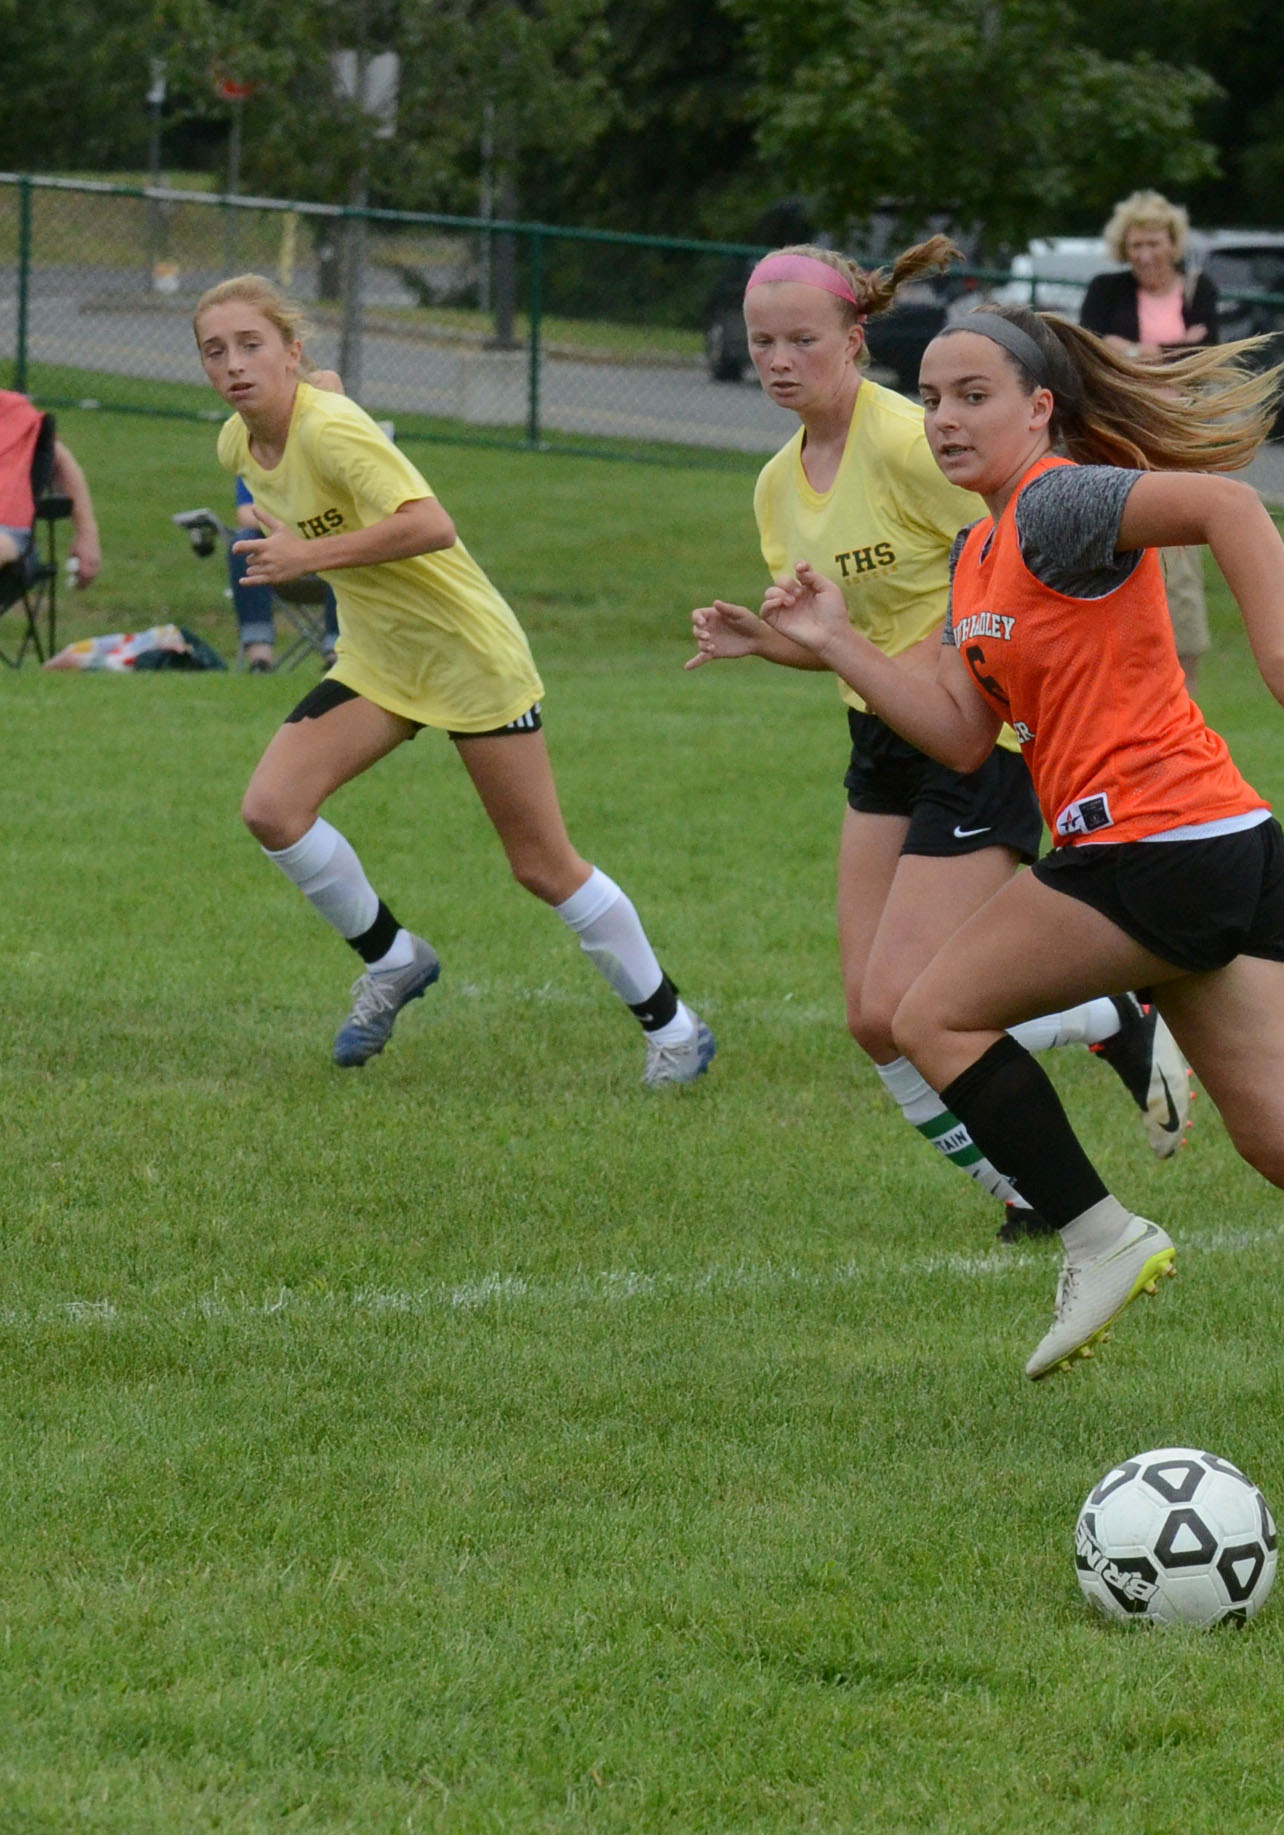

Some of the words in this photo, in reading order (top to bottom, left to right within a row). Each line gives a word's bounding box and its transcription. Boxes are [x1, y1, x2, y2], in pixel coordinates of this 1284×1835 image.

[297, 508, 344, 540] THS
[835, 541, 896, 577] THS
[1076, 1523, 1160, 1602] BRINE
